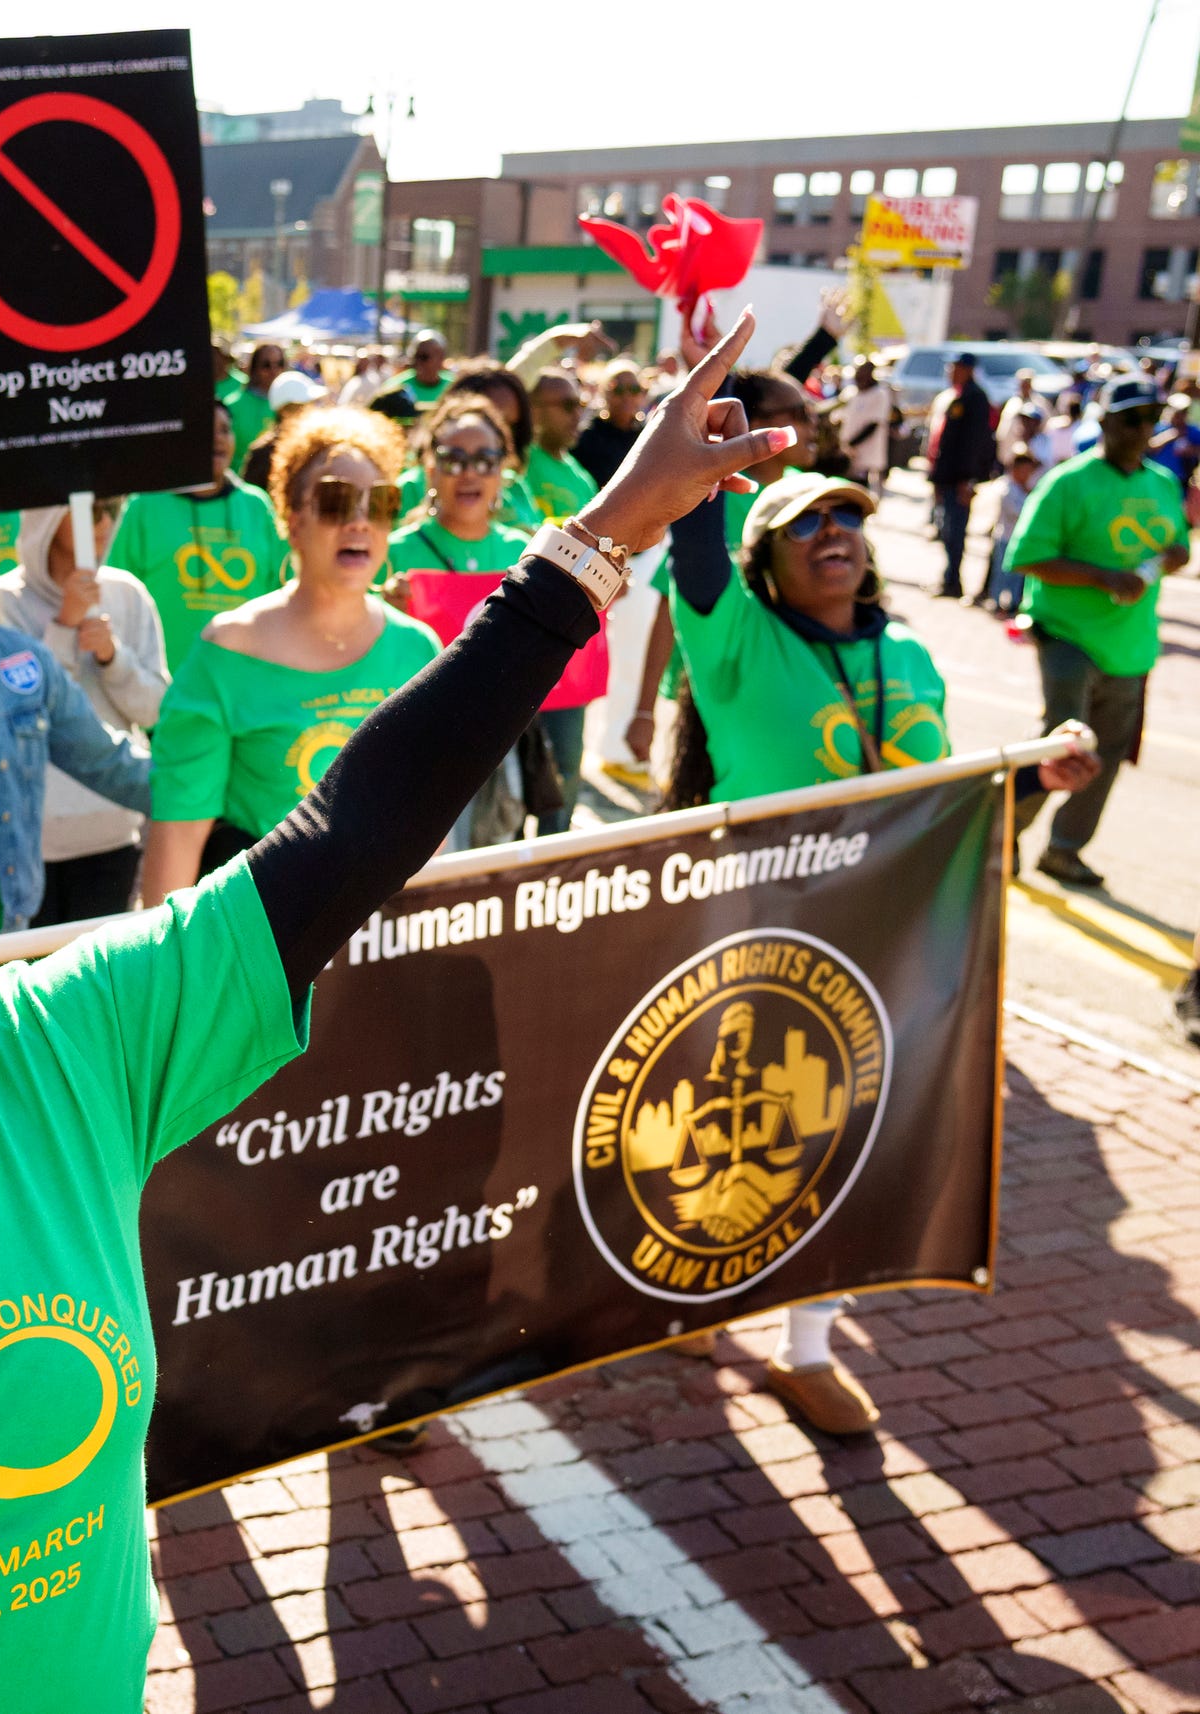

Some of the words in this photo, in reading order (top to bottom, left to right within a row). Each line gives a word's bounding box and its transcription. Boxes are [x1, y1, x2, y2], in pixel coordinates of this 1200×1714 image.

[867, 221, 965, 241] PARKING
[29, 358, 117, 391] Project
[121, 349, 187, 379] 2025
[49, 396, 106, 424] Now
[349, 896, 503, 967] Human
[514, 864, 651, 933] Rights
[661, 831, 869, 904] Committee
[586, 1088, 627, 1170] CIVIL
[607, 1056, 640, 1084] &
[625, 959, 719, 1058] HUMAN
[721, 942, 812, 985] RIGHTS
[806, 961, 884, 1108] COMMITTEE
[216, 1094, 351, 1166] “Civil
[355, 1070, 506, 1138] Rights
[320, 1164, 400, 1215] are
[172, 1244, 358, 1327] Human
[365, 1185, 540, 1270] Rights”
[631, 1233, 704, 1290] UAW
[703, 1221, 803, 1290] LOCAL
[801, 1190, 822, 1218] 7
[10, 1562, 81, 1611] 2025
